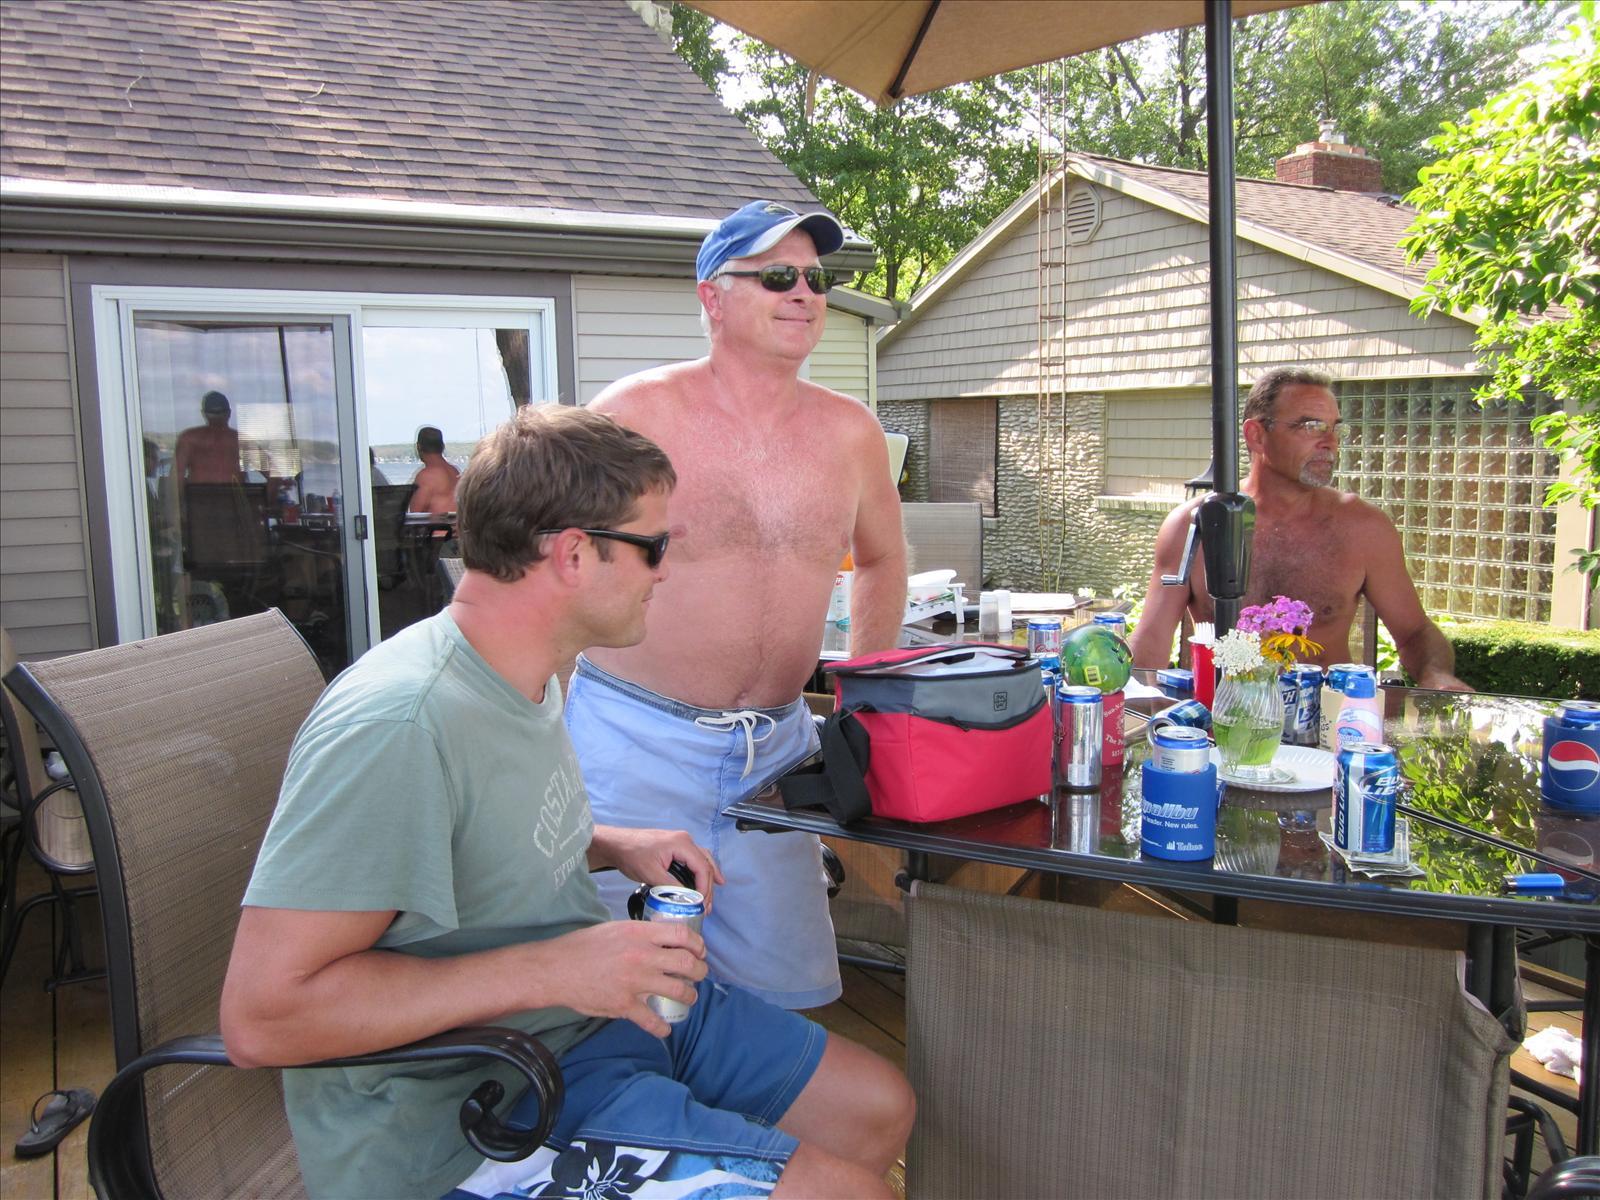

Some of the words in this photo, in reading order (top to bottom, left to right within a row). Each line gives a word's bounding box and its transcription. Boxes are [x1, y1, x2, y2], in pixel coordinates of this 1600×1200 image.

[1375, 774, 1400, 787] BU
[1362, 784, 1396, 796] LIG
[1165, 821, 1180, 829] New
[1337, 810, 1345, 845] BUD
